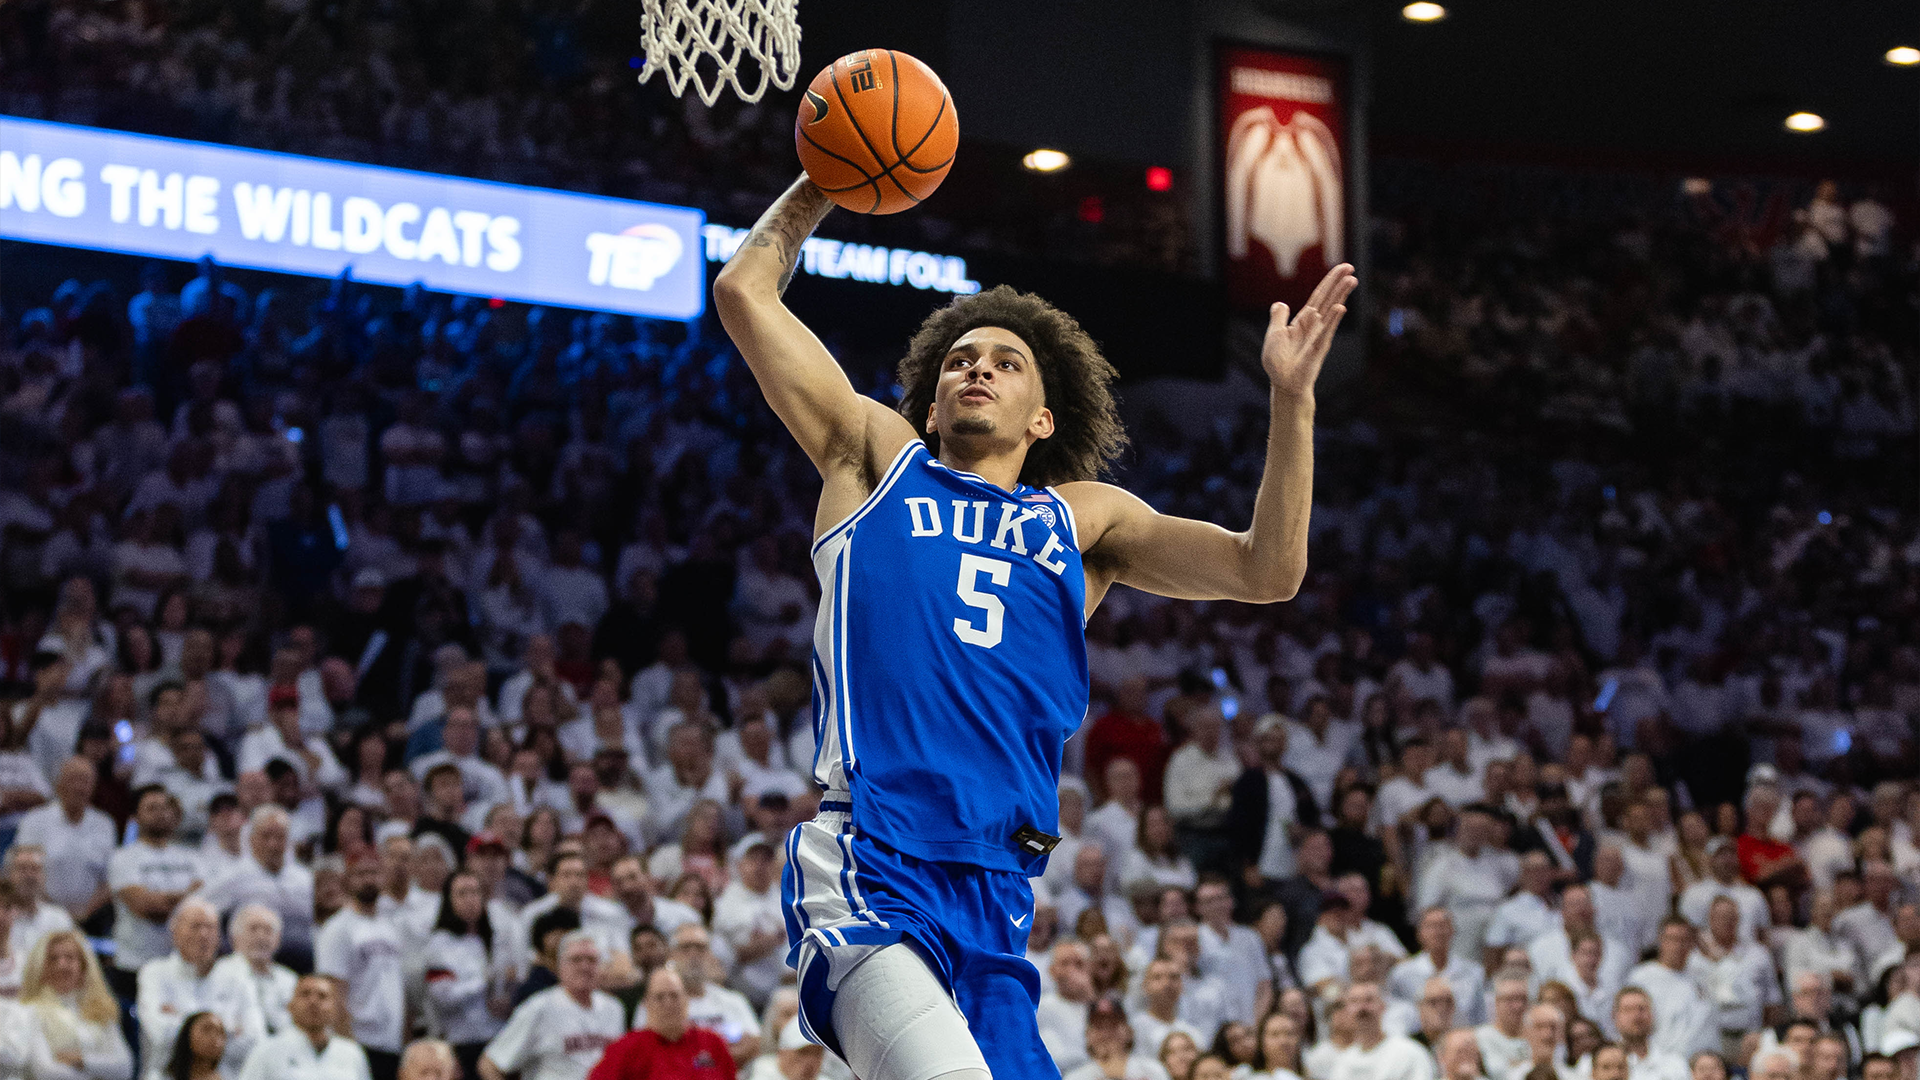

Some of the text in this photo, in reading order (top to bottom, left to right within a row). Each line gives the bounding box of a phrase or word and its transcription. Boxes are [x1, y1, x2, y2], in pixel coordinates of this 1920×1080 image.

[100, 163, 221, 235] THE
[233, 181, 522, 273] WILDCATS
[700, 224, 751, 263] TH
[800, 237, 889, 284] TEAM
[904, 497, 1067, 576] DUKE
[953, 552, 1012, 649] 5
